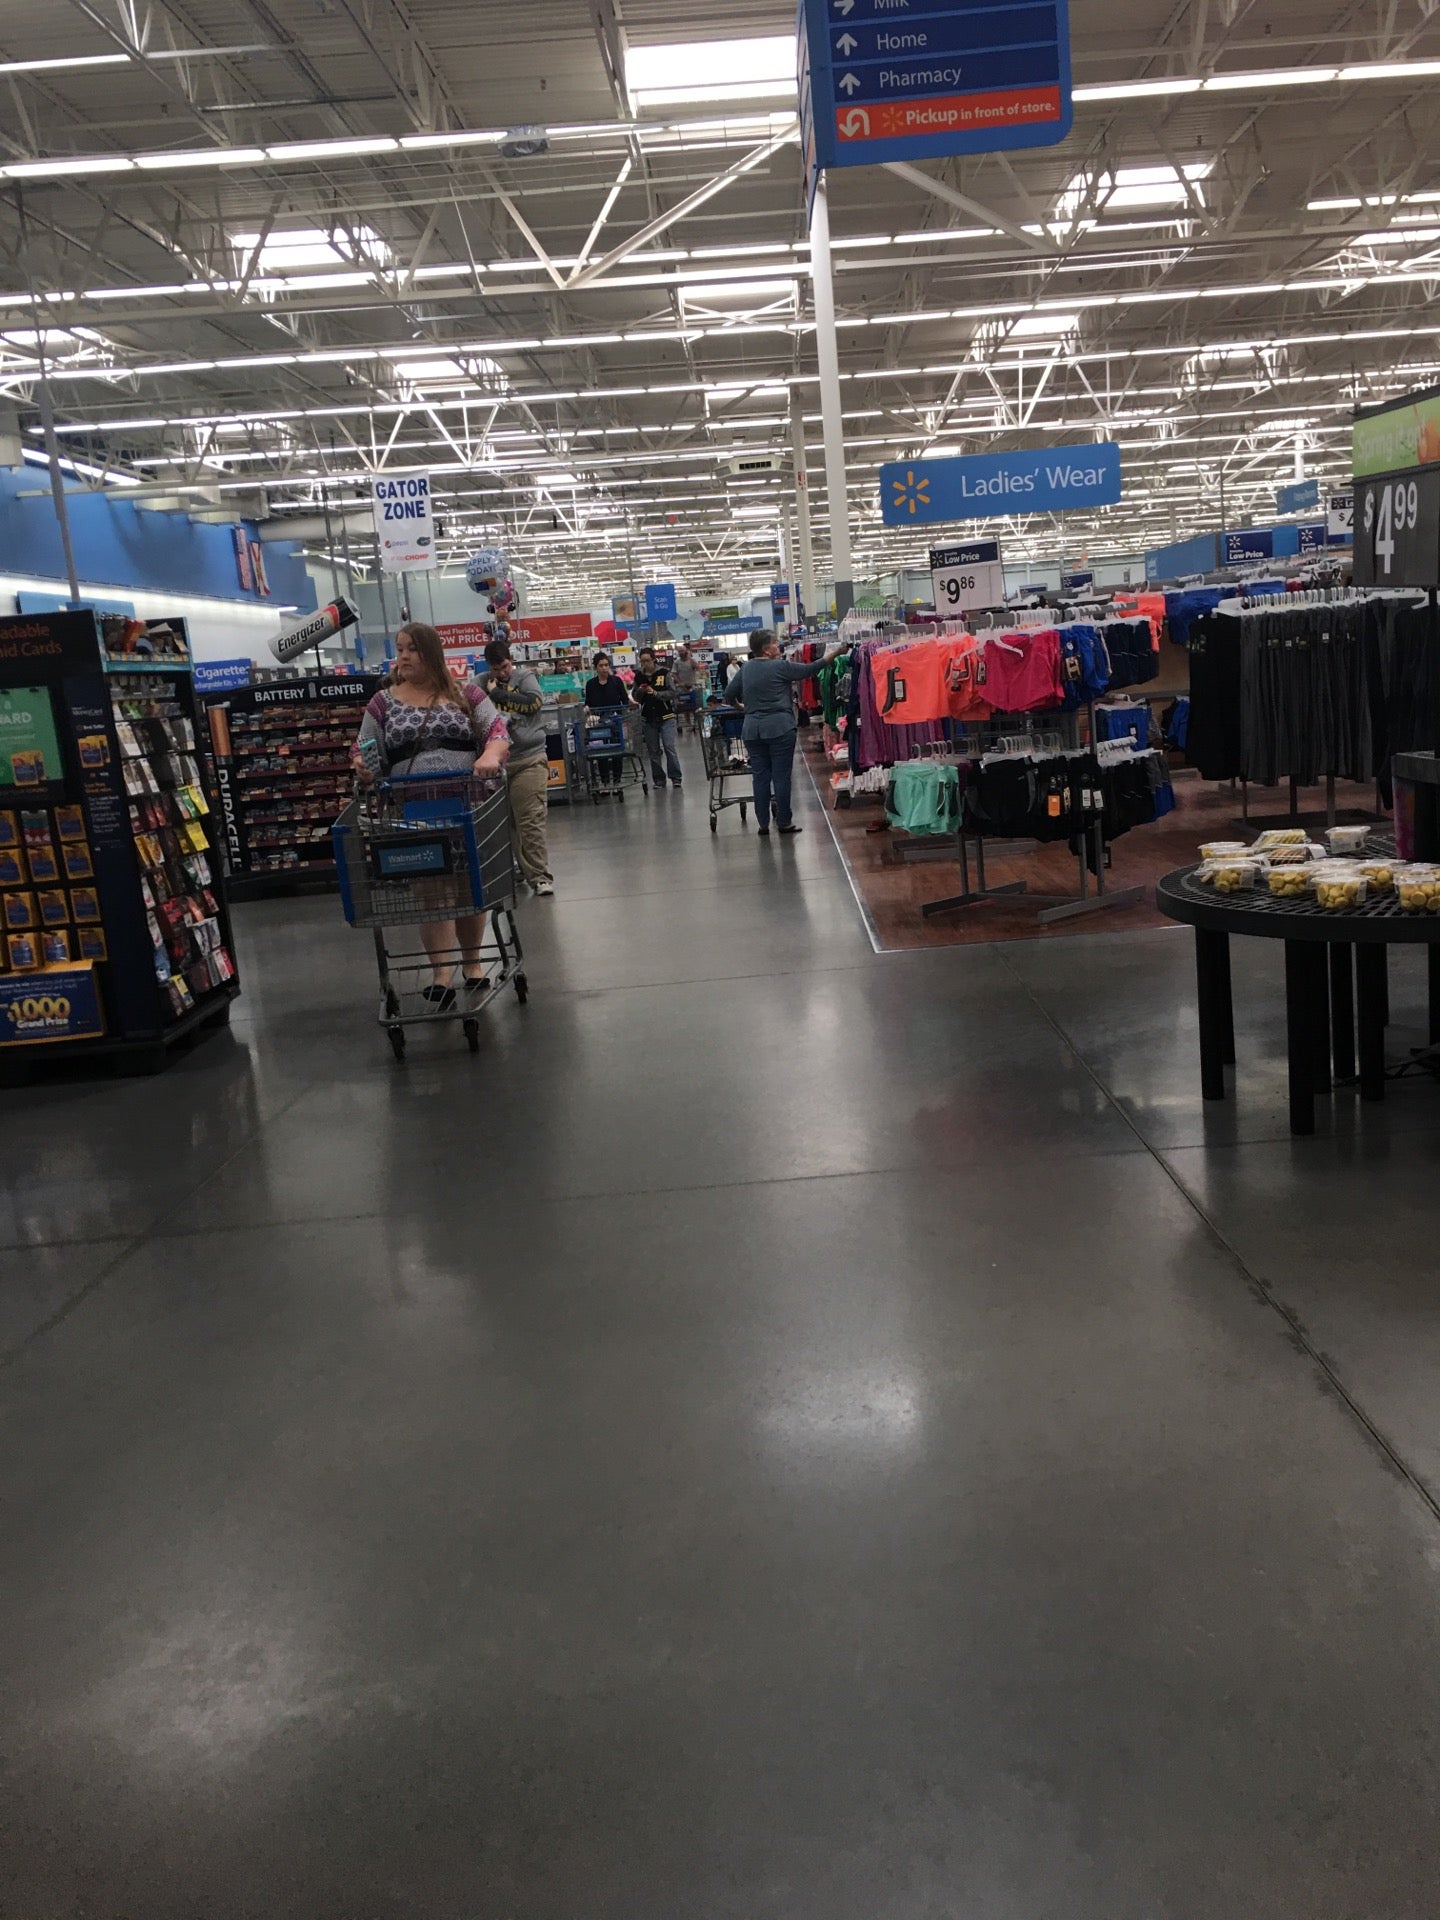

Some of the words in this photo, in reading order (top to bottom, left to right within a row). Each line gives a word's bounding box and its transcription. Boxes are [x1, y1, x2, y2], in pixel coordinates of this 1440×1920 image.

[876, 31, 928, 50] Home
[879, 68, 962, 88] Pharmacy
[906, 107, 958, 125] Pickup
[961, 108, 972, 120] in
[975, 105, 1004, 118] front
[1007, 103, 1020, 115] of
[1022, 102, 1056, 113] store.
[375, 478, 429, 499] GATOR
[961, 467, 1040, 498] Ladies’
[1045, 465, 1107, 489] Wear
[383, 500, 426, 520] ZONE
[468, 557, 492, 567] APPLY
[944, 555, 960, 565] Low
[960, 552, 980, 562] Price
[1229, 552, 1245, 560] Low
[1245, 550, 1264, 558] Price
[740, 621, 760, 629] Center
[277, 617, 325, 653] Energizer
[440, 635, 456, 646] OW
[458, 632, 489, 645] PRICE
[21, 640, 63, 657] Cards
[254, 688, 305, 702] BATTERY
[320, 683, 364, 697] CENTER
[218, 769, 242, 869] DURACELL
[387, 852, 422, 864] Walmart
[16, 1019, 45, 1029] Grand
